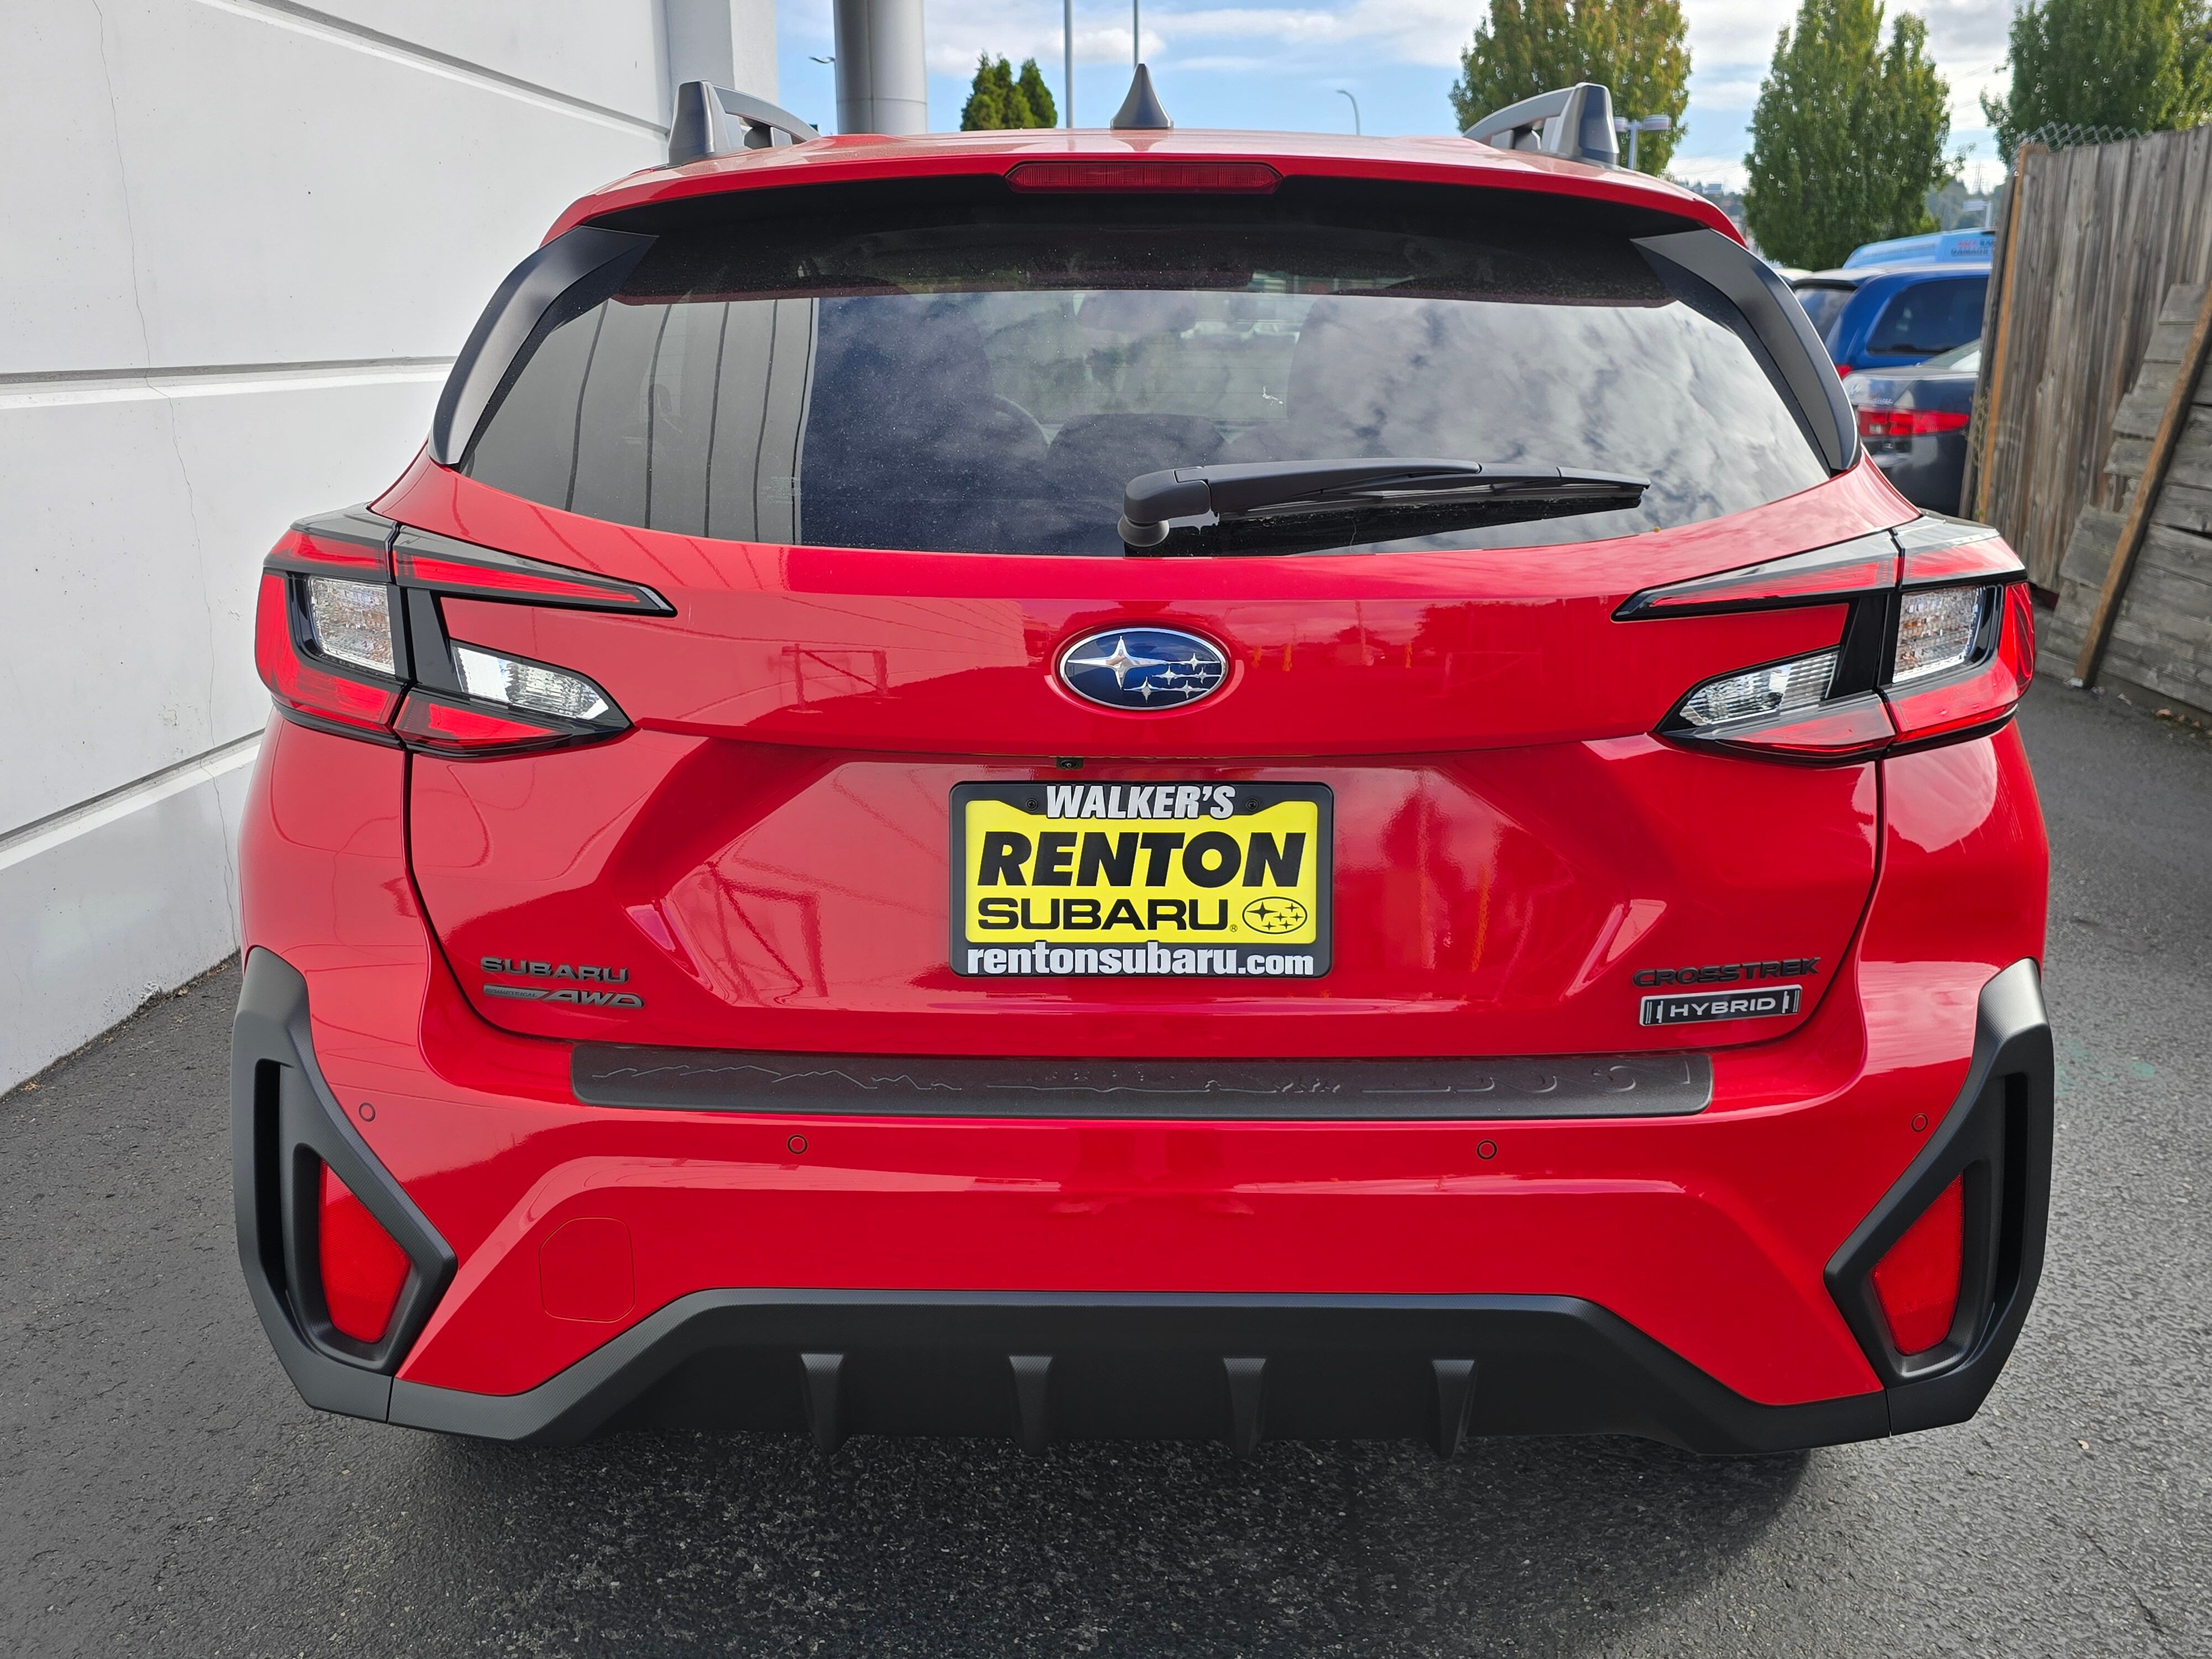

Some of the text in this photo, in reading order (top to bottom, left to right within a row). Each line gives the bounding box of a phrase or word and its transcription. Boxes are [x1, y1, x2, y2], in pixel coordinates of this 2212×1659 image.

[1046, 785, 1237, 820] WALKER'S
[978, 831, 1307, 888] RENTON
[978, 897, 1229, 931] SUBARU
[480, 956, 629, 983] SUBARU
[967, 941, 1314, 975] rentonsubaru.com
[1632, 957, 1822, 988] CROSSTREK
[541, 988, 645, 1009] AWD
[1669, 997, 1777, 1018] HYBRID
